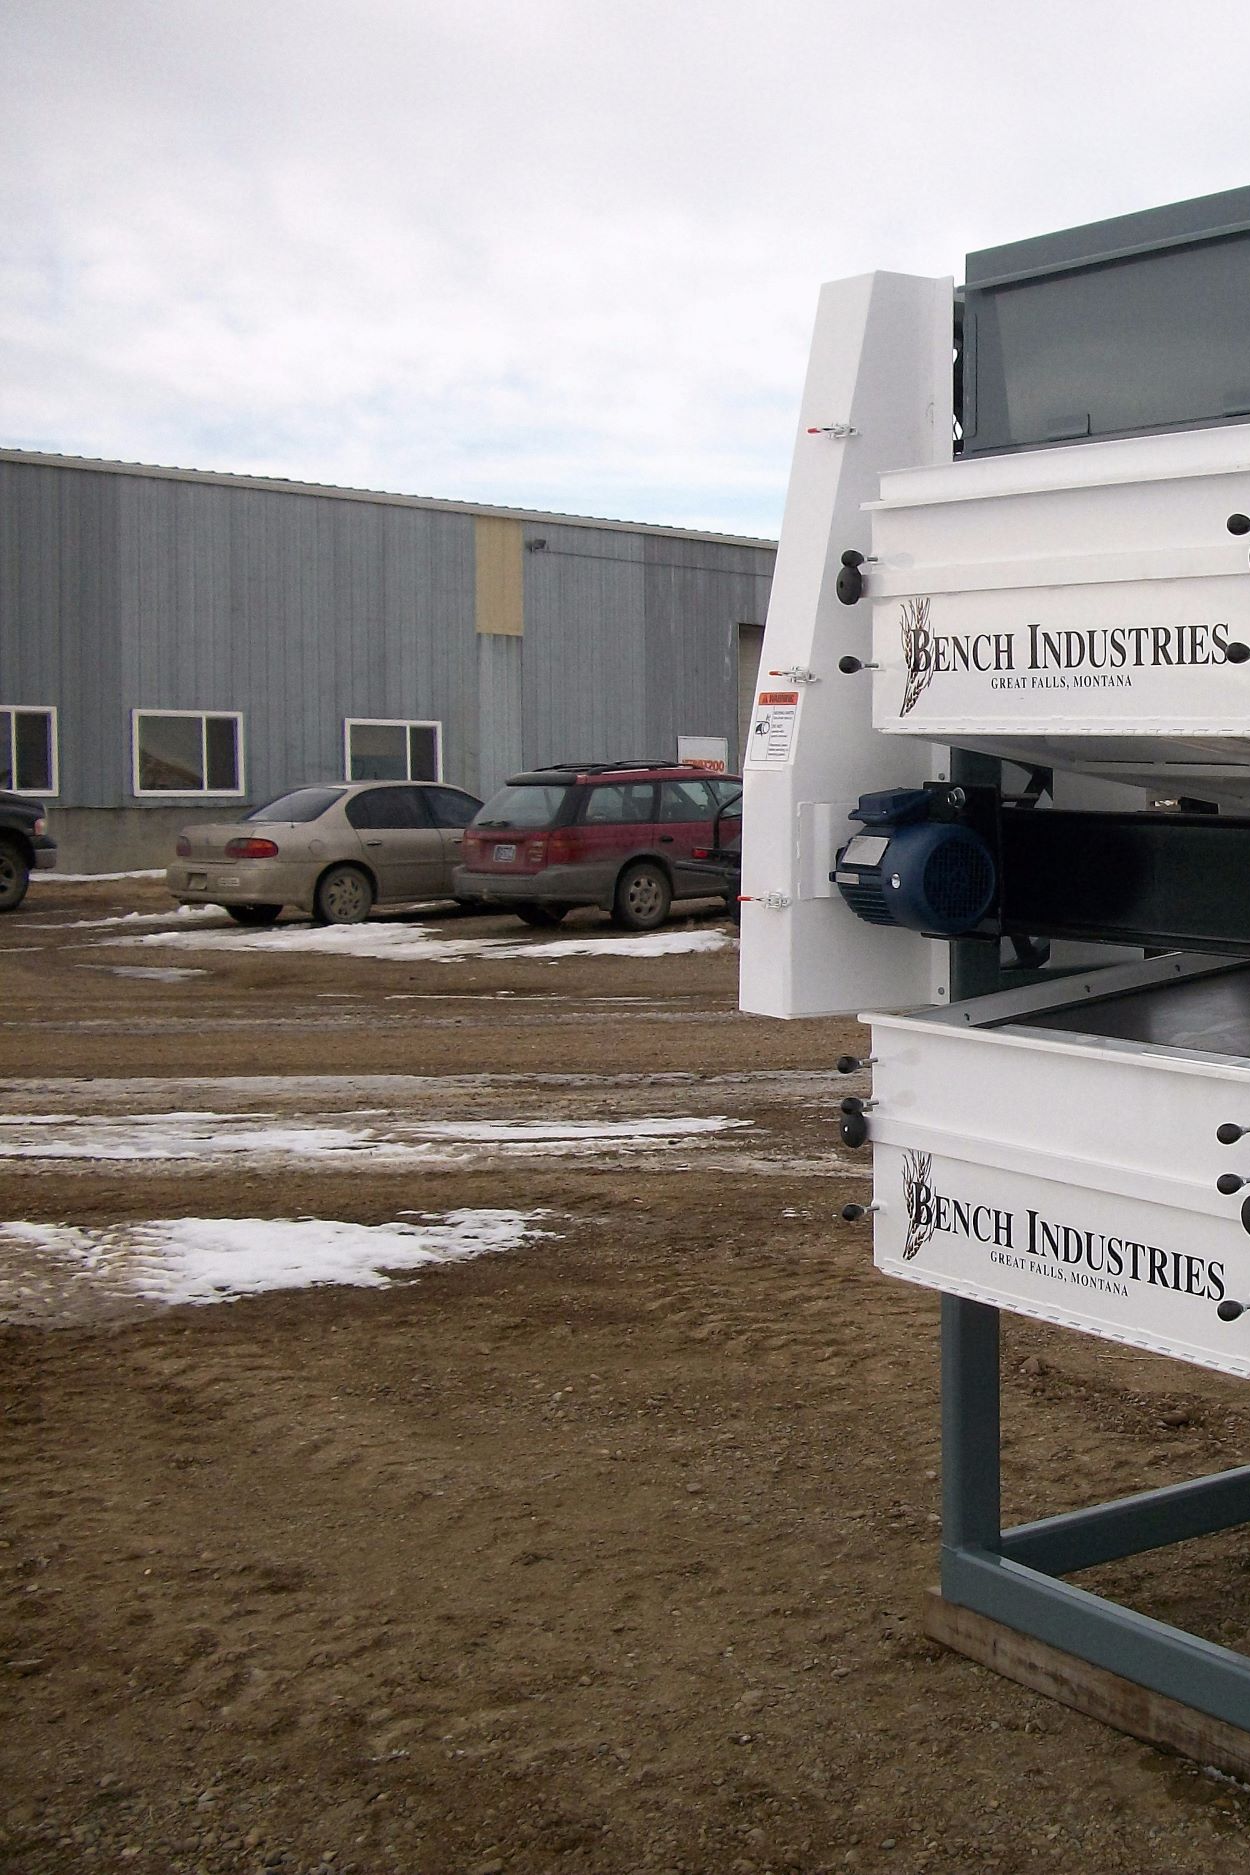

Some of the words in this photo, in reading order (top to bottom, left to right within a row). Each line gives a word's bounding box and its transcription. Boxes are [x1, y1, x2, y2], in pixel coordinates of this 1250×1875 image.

[911, 628, 1015, 673] BENCH
[1027, 623, 1229, 670] INDUSTRIES
[991, 677, 1027, 689] GREAT
[1031, 676, 1069, 690] FALLS,
[1073, 674, 1132, 688] MONTANA
[913, 1181, 1014, 1248] BENCH
[1026, 1209, 1225, 1301] INDUSTRIES
[990, 1250, 1026, 1269] GREAT
[1030, 1261, 1067, 1282] FALLS,
[1071, 1272, 1128, 1297] MONTANA
